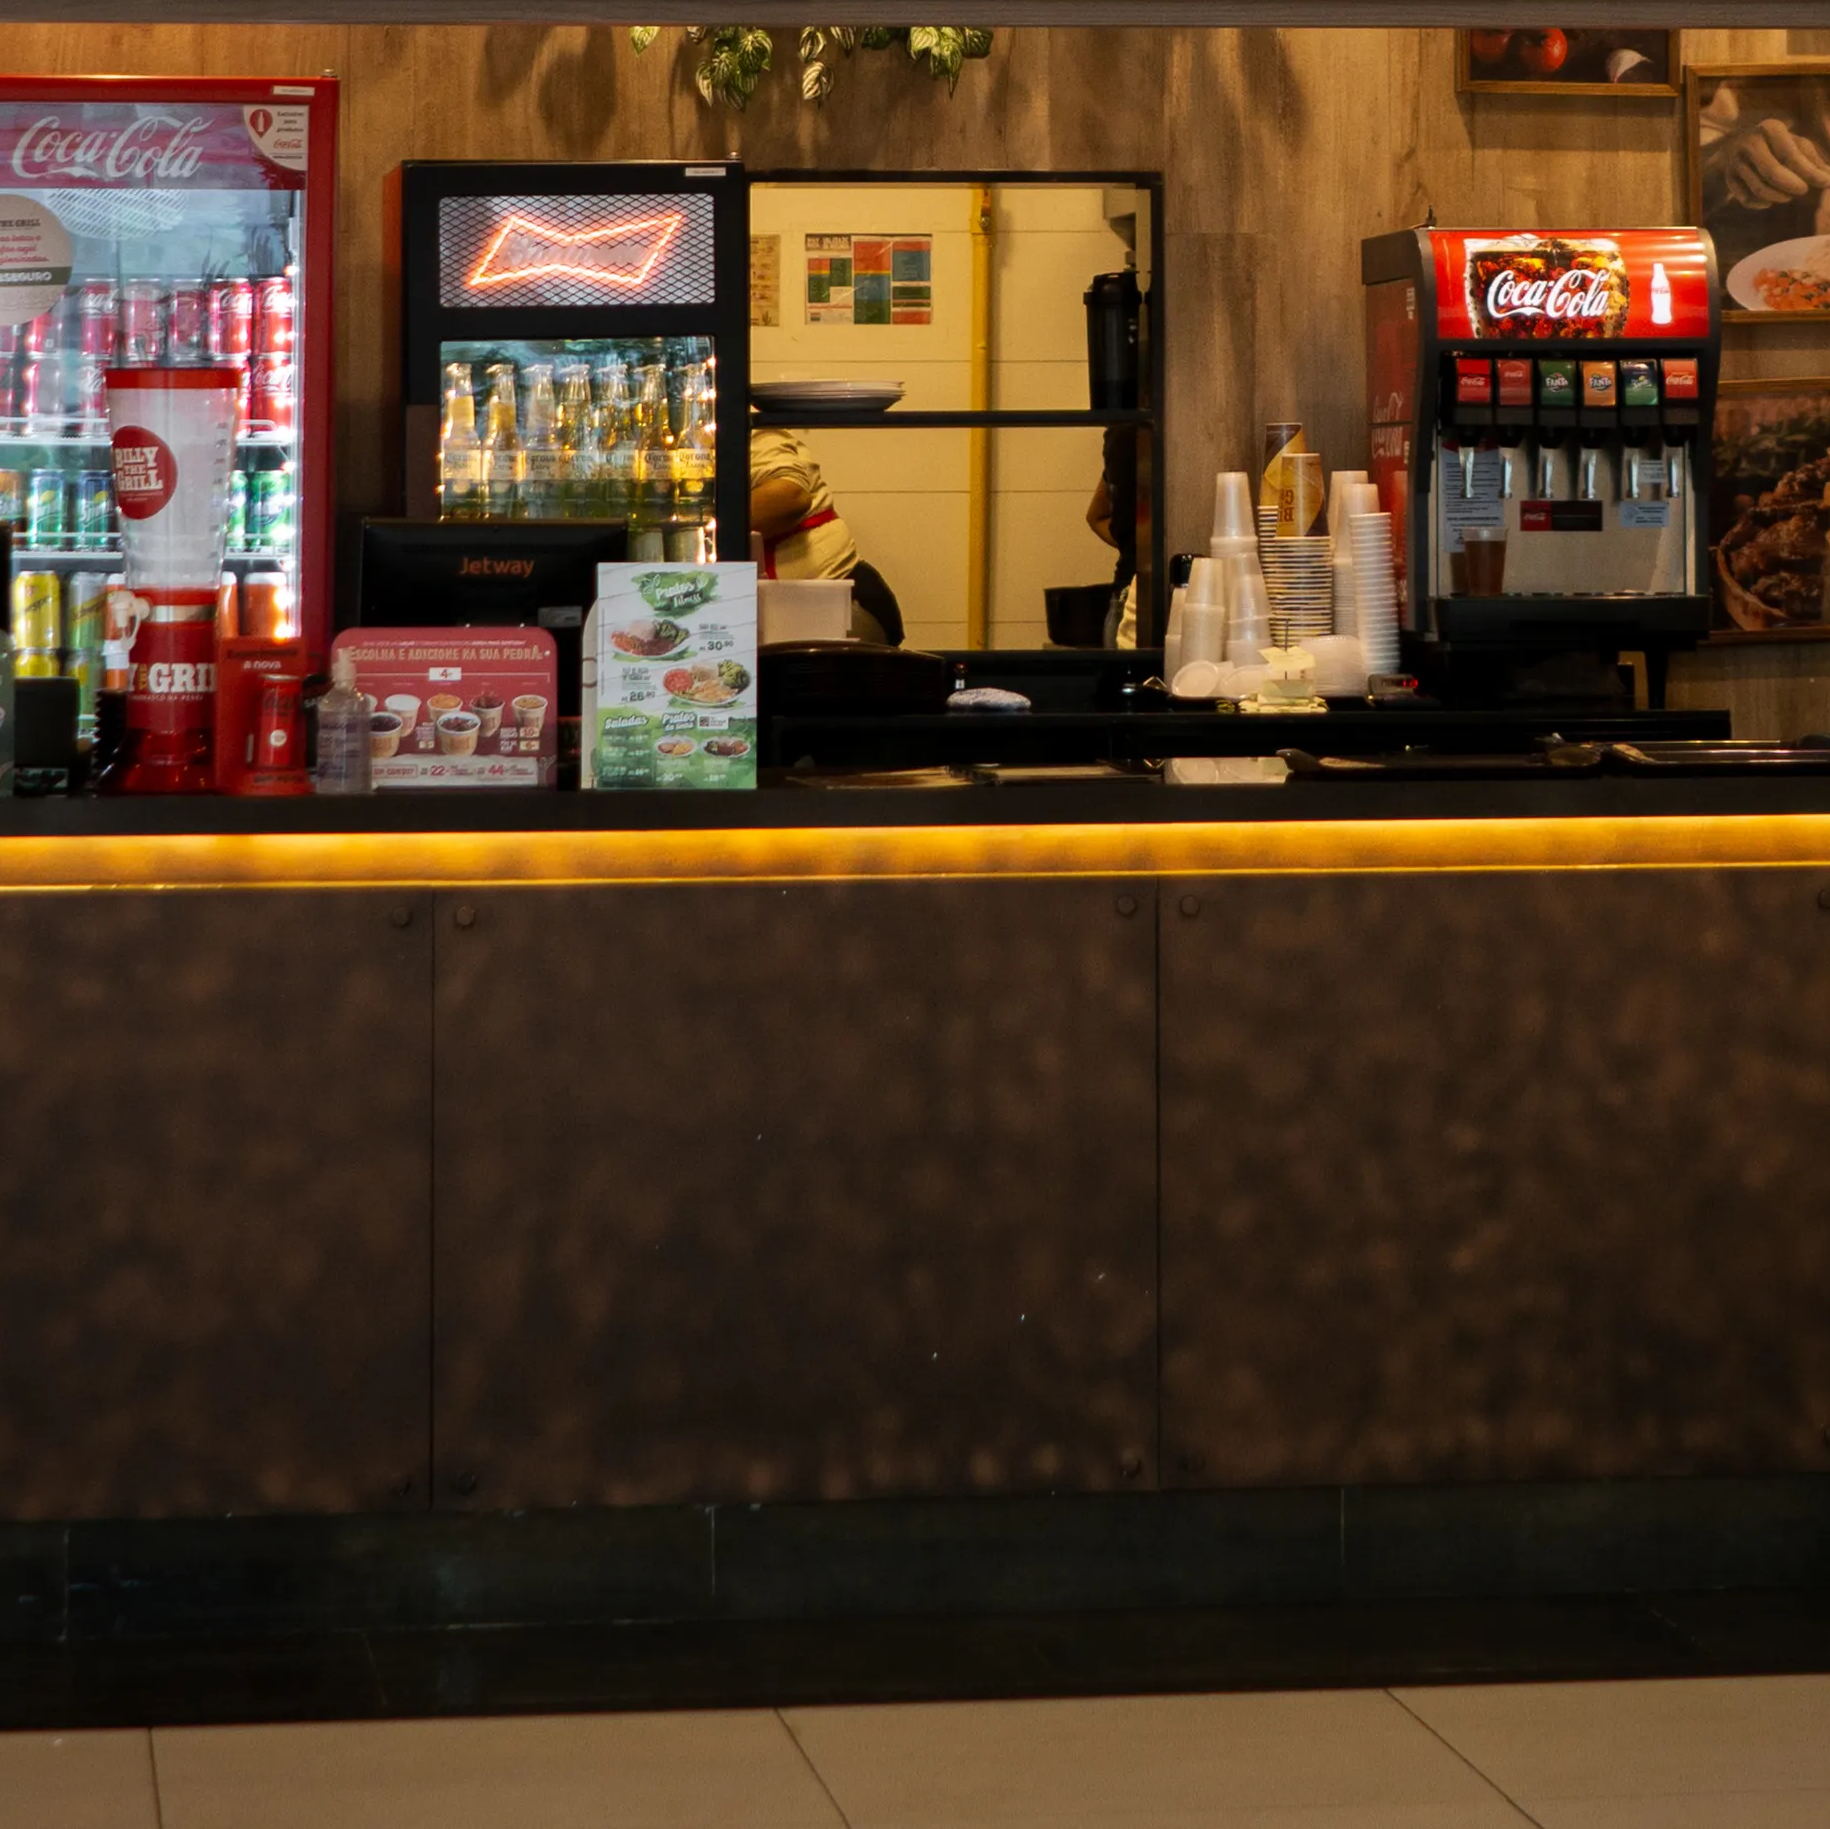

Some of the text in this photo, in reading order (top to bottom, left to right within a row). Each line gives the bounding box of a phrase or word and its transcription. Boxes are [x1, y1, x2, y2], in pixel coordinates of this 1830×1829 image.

[1486, 268, 1611, 319] Coca-Cola
[115, 446, 159, 469] BILLY
[117, 469, 164, 491] GRILL
[459, 556, 535, 579] Jetway
